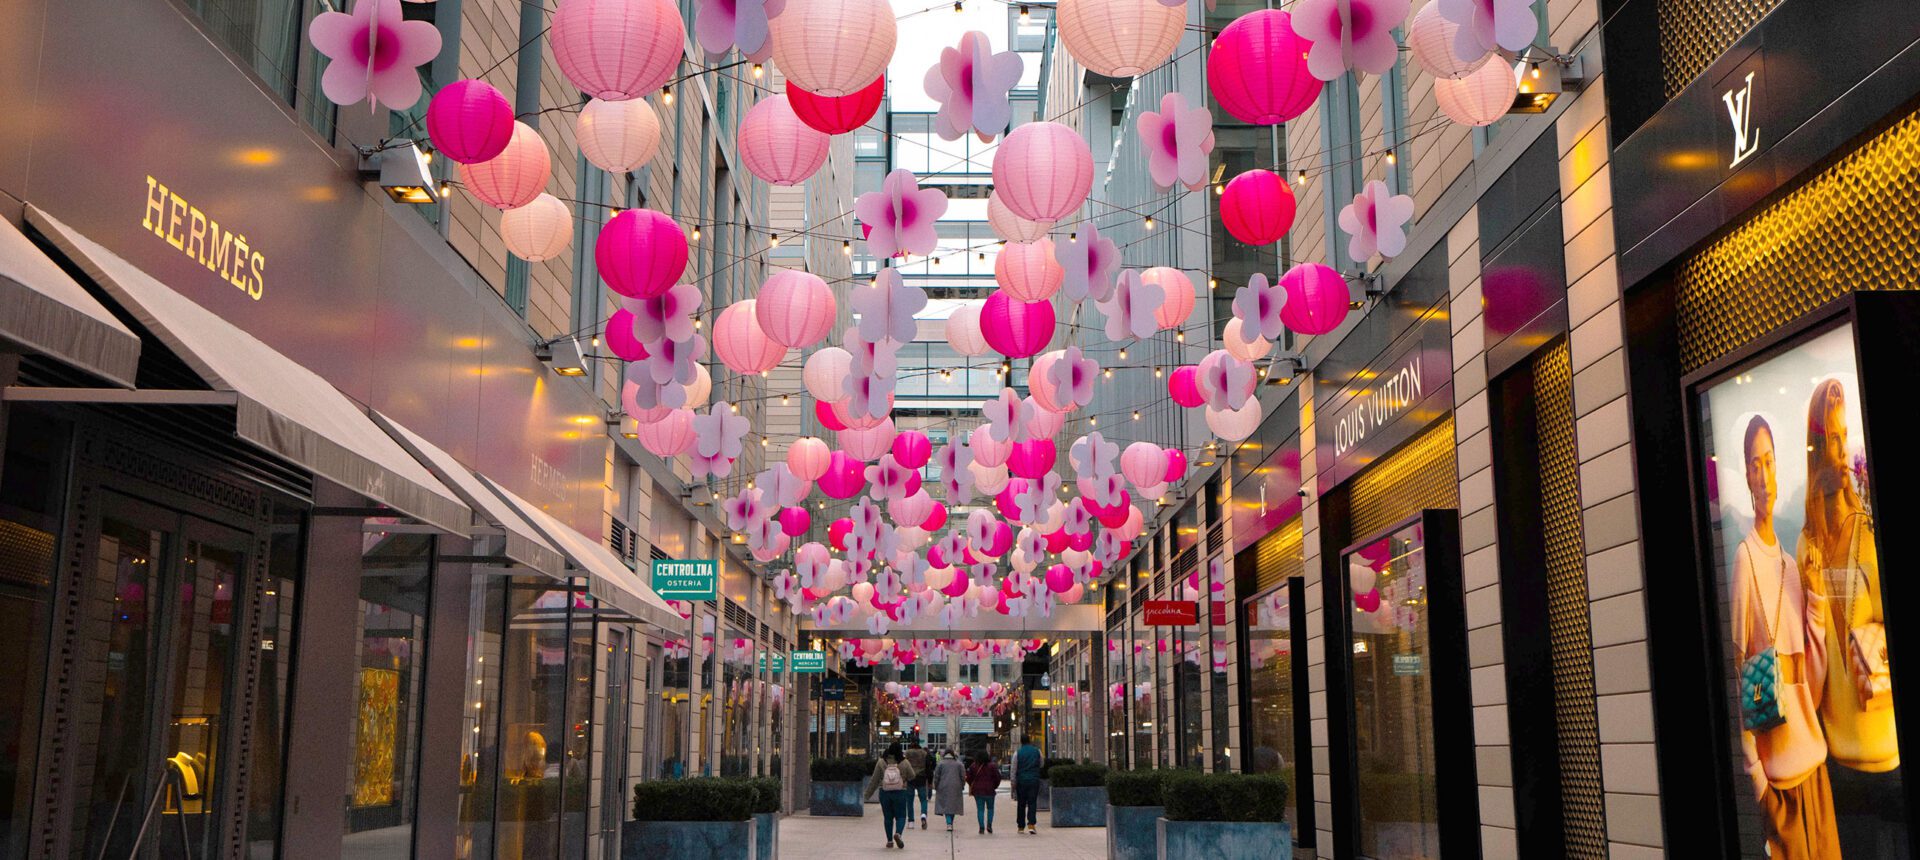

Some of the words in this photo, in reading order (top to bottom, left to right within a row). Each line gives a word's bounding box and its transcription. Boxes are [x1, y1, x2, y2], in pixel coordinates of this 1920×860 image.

[142, 175, 265, 301] HERMÈS
[1335, 403, 1365, 456] LOUIS
[1367, 357, 1422, 430] VUITTON
[656, 563, 713, 576] CENTROLINA
[793, 652, 824, 660] CENTROLINA
